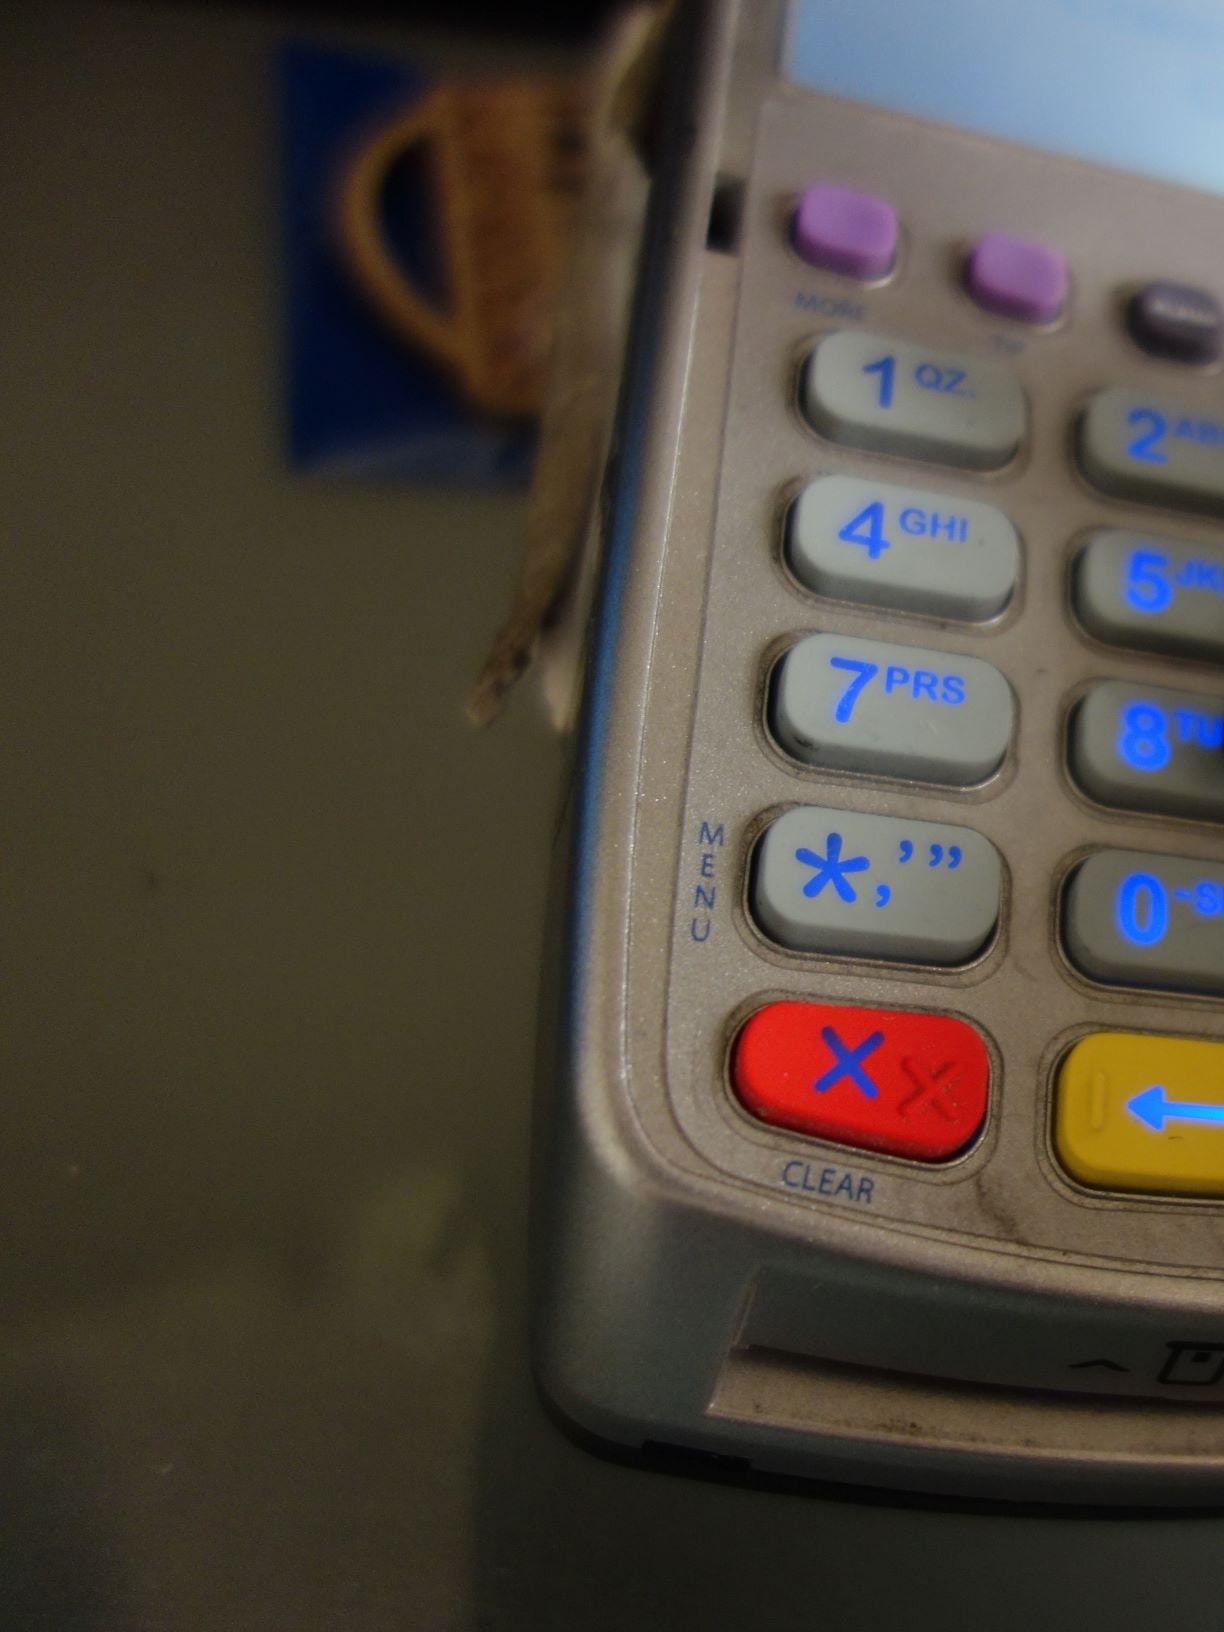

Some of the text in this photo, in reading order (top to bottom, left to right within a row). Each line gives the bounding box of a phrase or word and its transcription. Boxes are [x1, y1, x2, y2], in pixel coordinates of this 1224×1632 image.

[863, 354, 897, 409] 1
[1126, 408, 1168, 464] 2
[838, 501, 969, 560] 4 GHI
[1125, 549, 1173, 613] 5
[830, 656, 966, 724] 7 PRS
[1119, 702, 1171, 772] 8
[690, 821, 724, 942] MENU
[1117, 873, 1168, 945] 0
[781, 1160, 875, 1206] CLEAR
